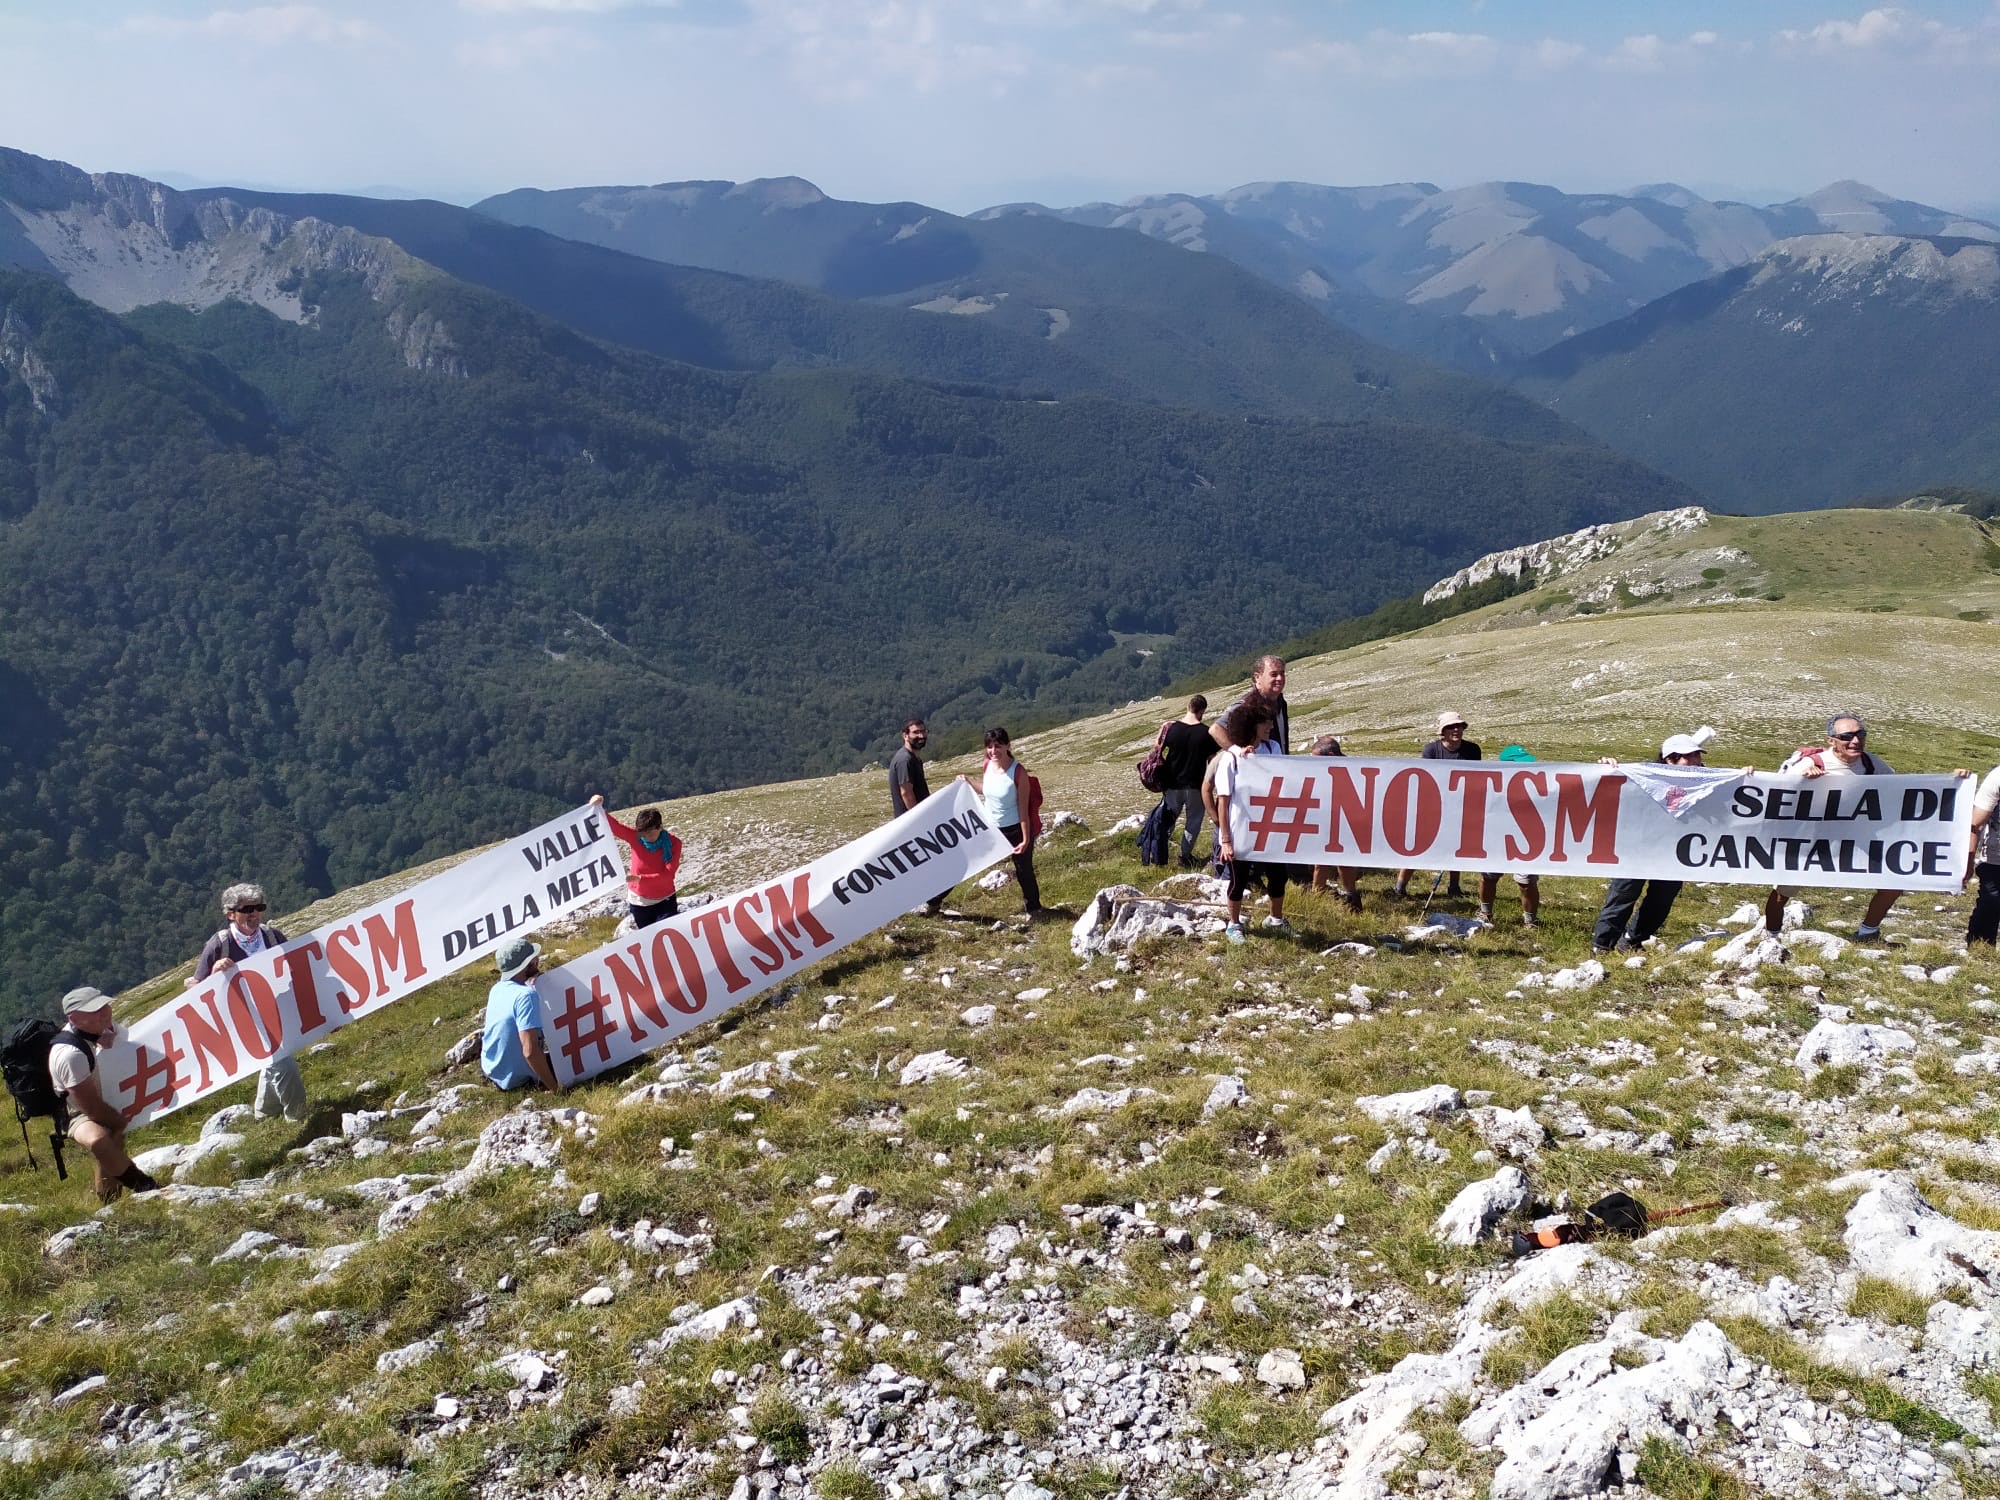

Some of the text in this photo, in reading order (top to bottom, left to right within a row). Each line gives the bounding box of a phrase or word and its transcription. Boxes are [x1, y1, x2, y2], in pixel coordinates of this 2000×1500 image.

[522, 814, 605, 871] VALLE
[1249, 767, 1627, 864] #NOTSM
[1732, 786, 1956, 822] SELLA DI
[834, 809, 987, 905] FONTENOVA
[1676, 833, 1952, 876] CANTALICE
[442, 855, 617, 961] DELLA META
[119, 899, 427, 1120] #NOTSM
[553, 873, 834, 1074] #NOTSM
